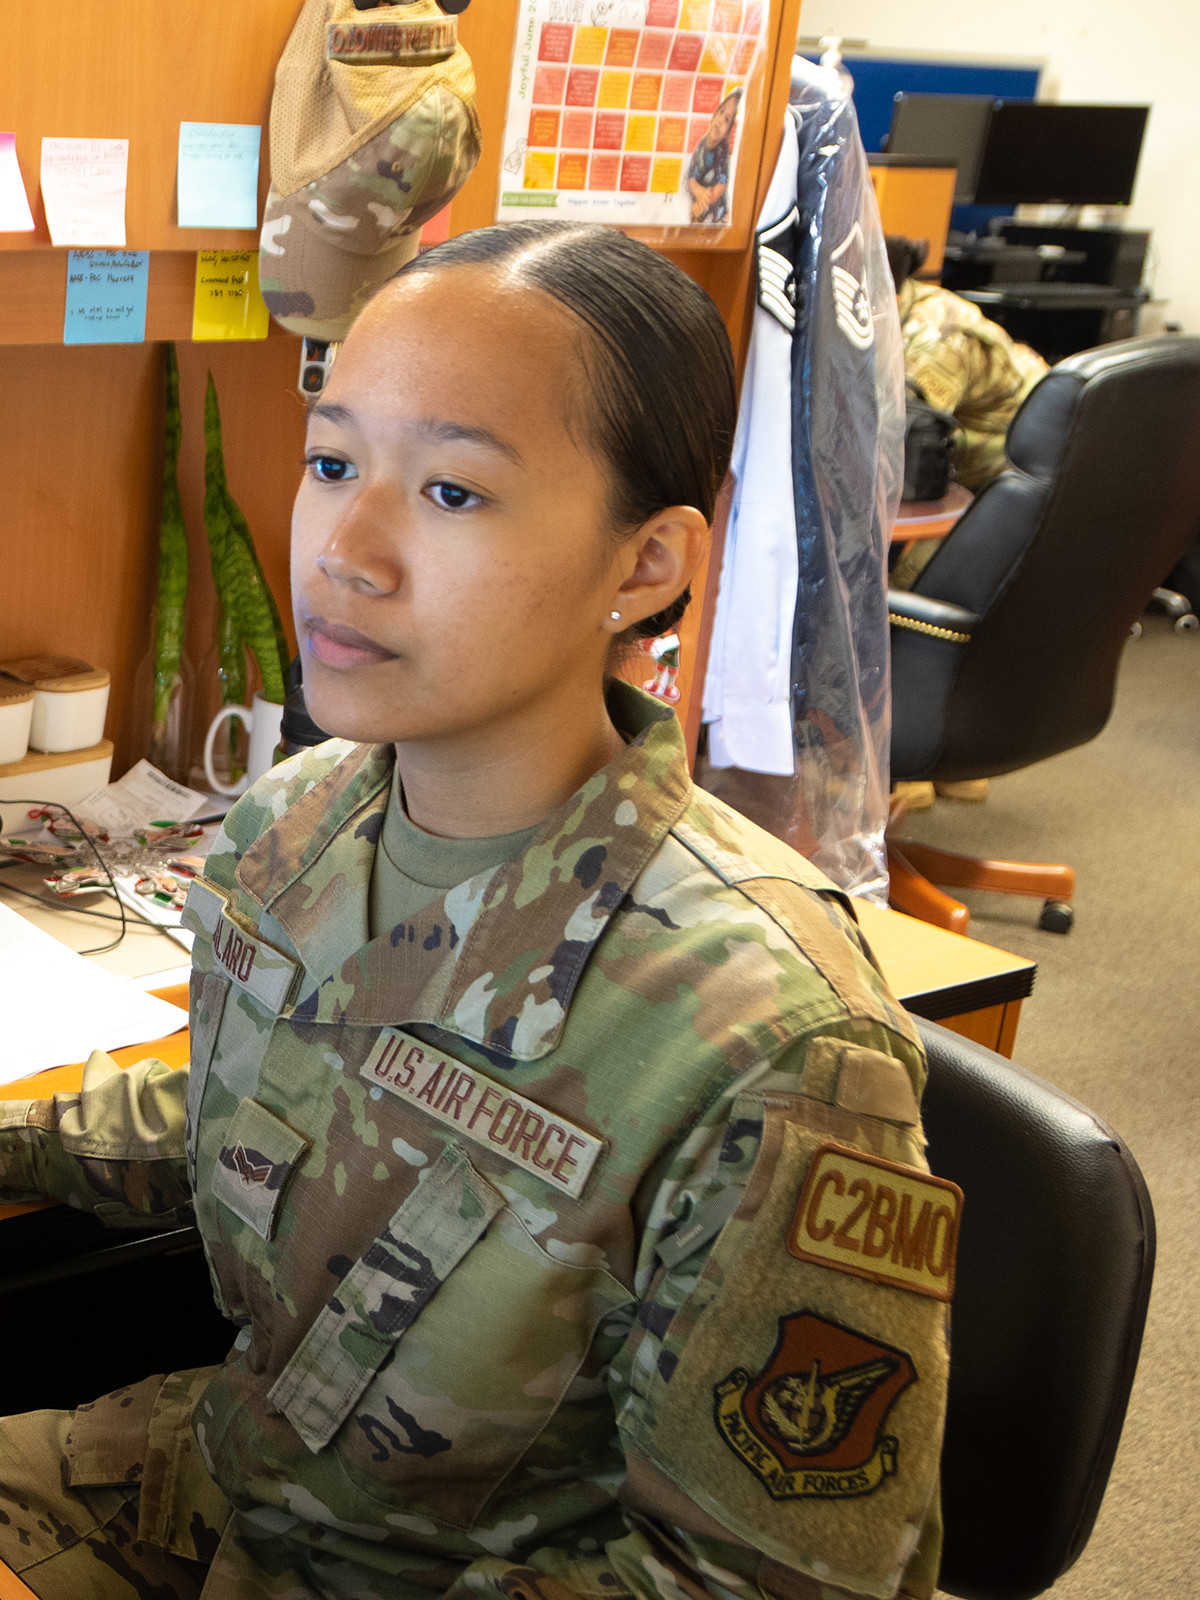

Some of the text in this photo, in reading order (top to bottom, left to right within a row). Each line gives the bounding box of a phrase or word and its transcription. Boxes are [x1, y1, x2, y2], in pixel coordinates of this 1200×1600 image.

[523, 17, 535, 51] June
[517, 54, 531, 100] Joyful
[417, 1061, 476, 1121] AIR
[466, 1085, 588, 1185] FORCE
[766, 1467, 871, 1492] AIR FORCES
